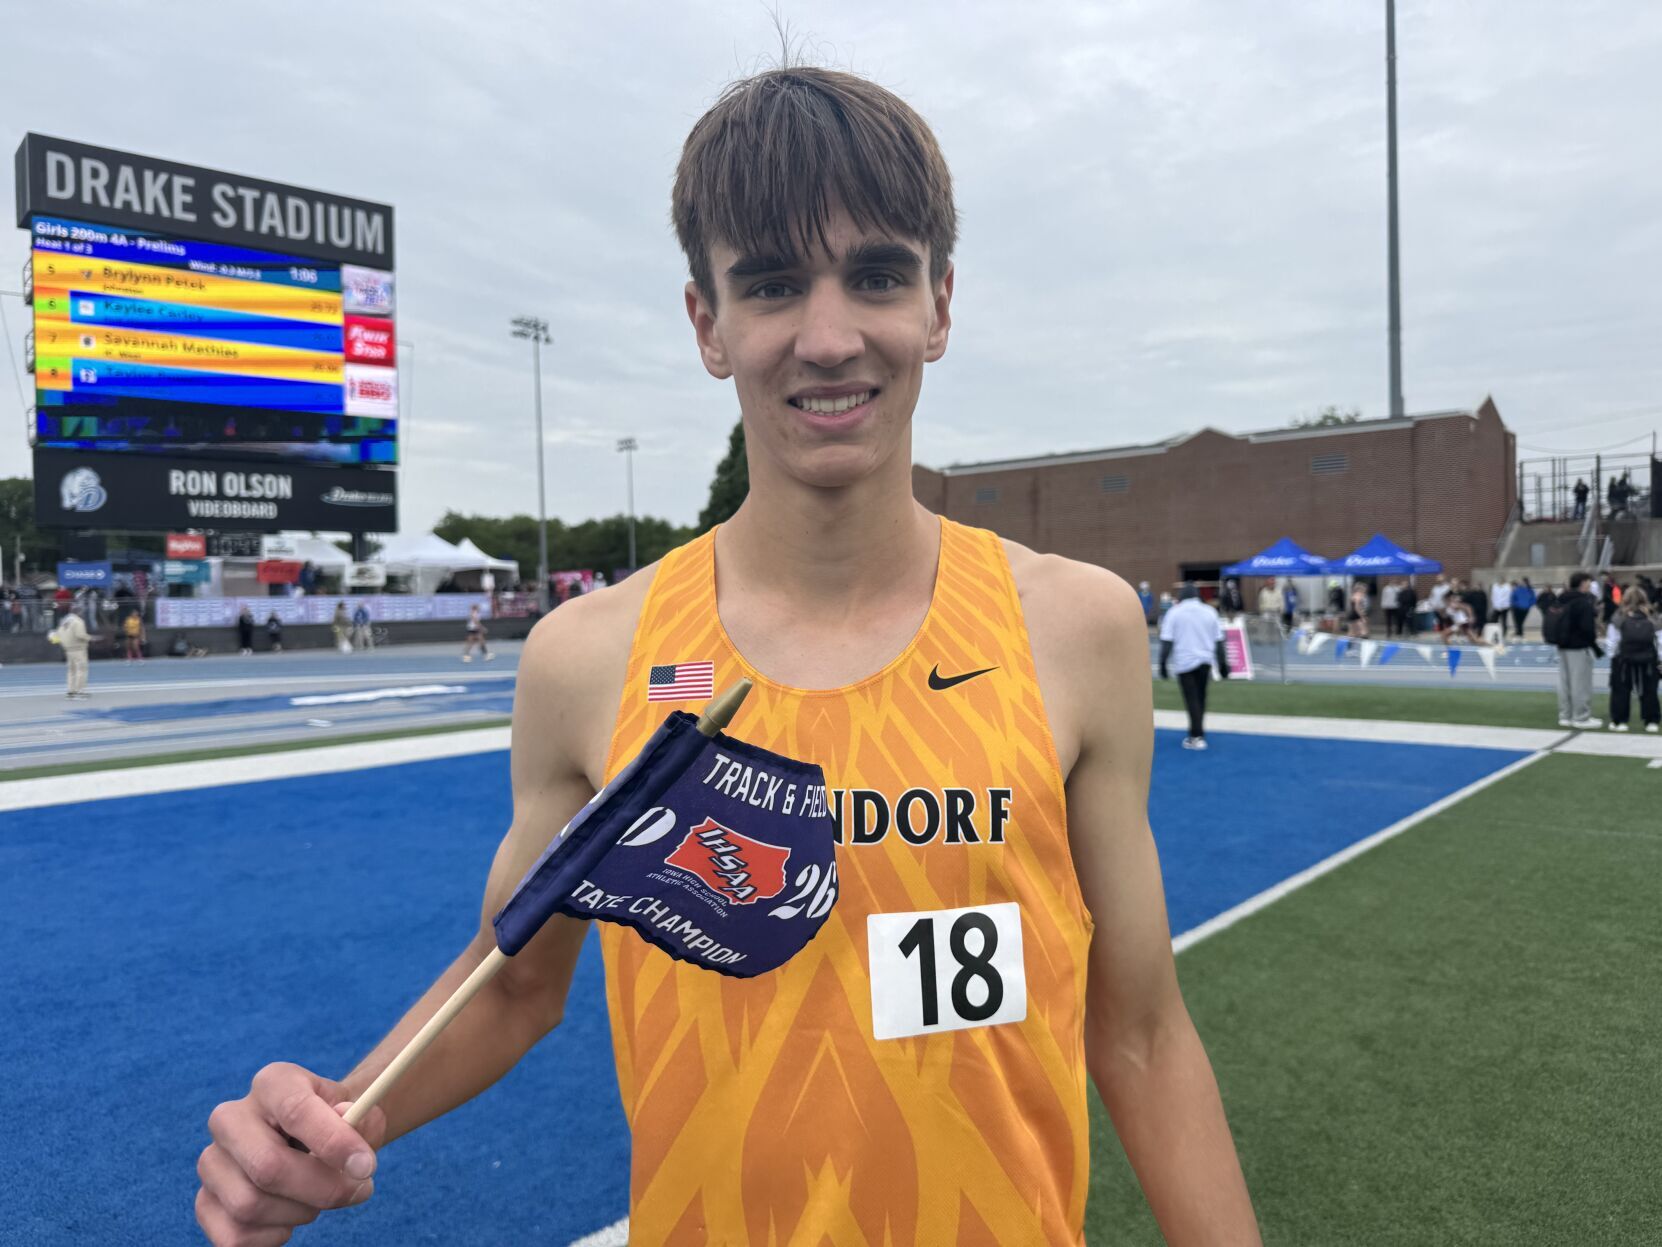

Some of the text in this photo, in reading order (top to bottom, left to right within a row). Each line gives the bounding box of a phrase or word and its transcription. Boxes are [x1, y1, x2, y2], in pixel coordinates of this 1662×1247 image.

[46, 150, 385, 254] DRAKE STADIUM
[36, 221, 68, 238] Girls
[70, 227, 107, 244] 200m
[136, 238, 186, 256] Prelims
[103, 267, 162, 286] Brylynn
[104, 333, 179, 352] Savannah
[169, 469, 292, 499] RON OLSON
[187, 499, 278, 519] VIDEOBOARD
[703, 753, 827, 818] TRACK & FIELD
[696, 828, 757, 901] IHSAA
[646, 873, 728, 918] ATHLETIC ASSOCIATION
[662, 868, 728, 907] IOWA HIGH SCHOOL
[768, 861, 837, 920] 26
[628, 897, 748, 965] CHAMPION
[898, 912, 1003, 1026] 18
